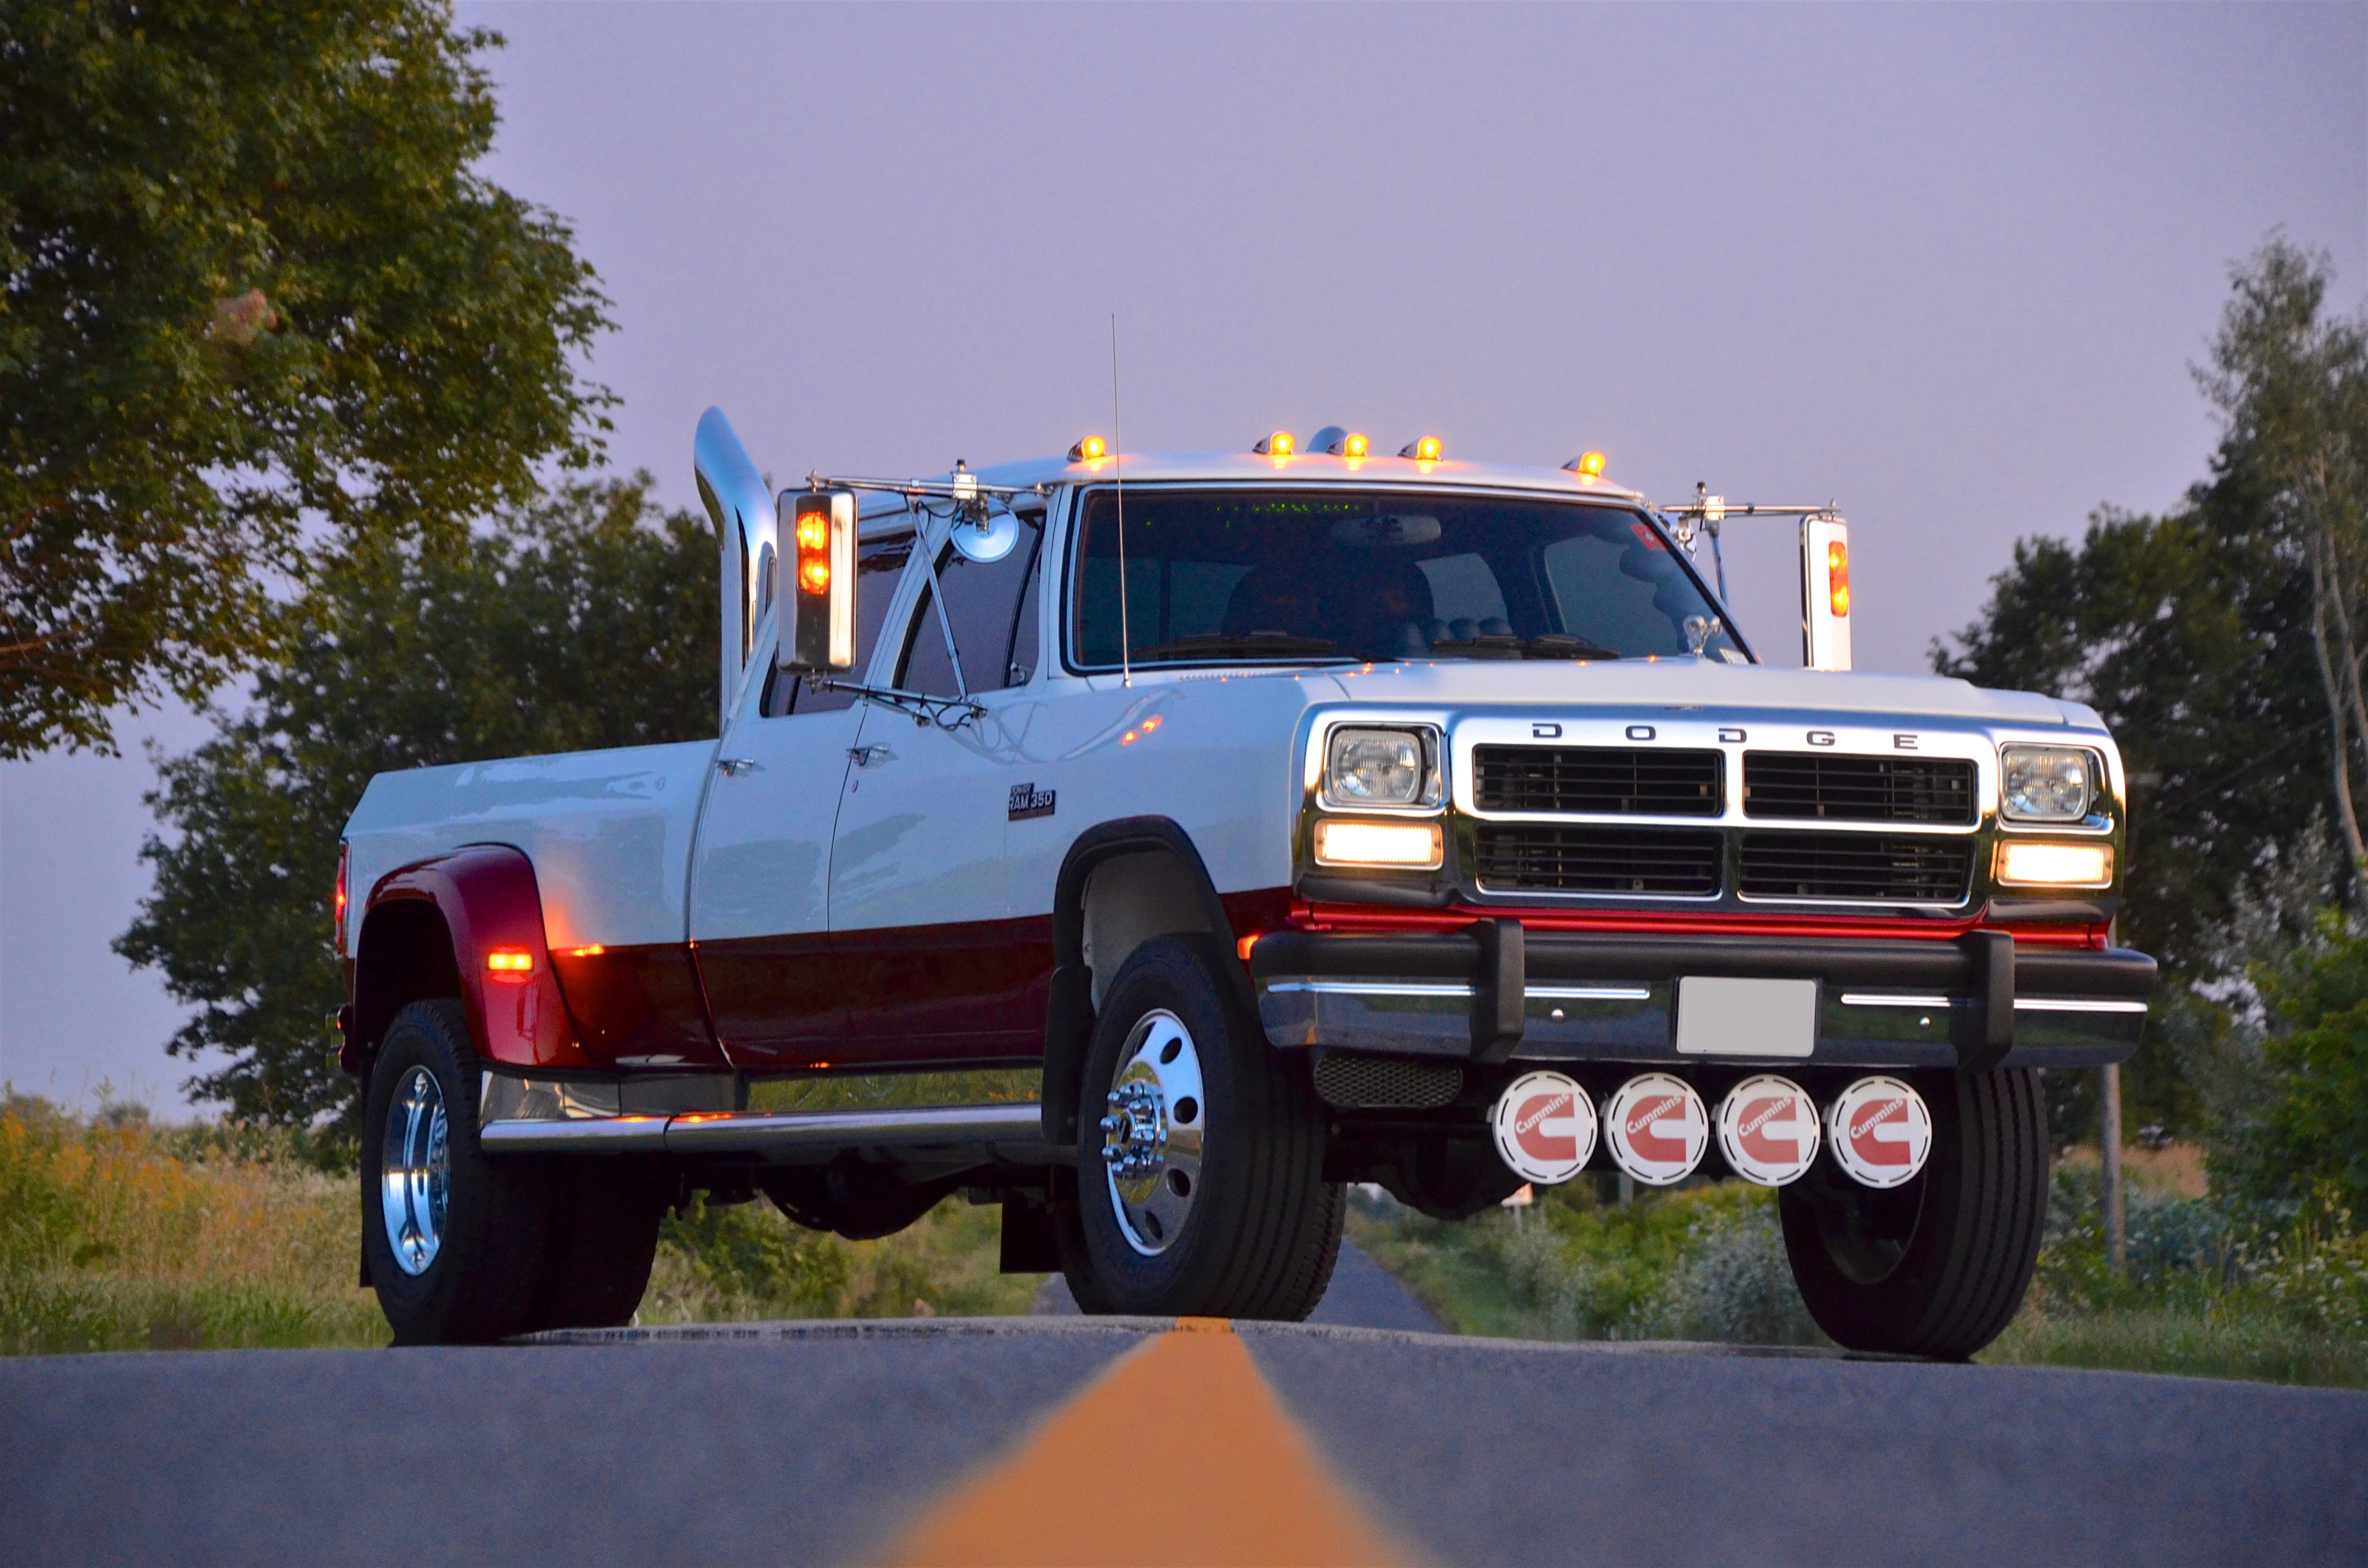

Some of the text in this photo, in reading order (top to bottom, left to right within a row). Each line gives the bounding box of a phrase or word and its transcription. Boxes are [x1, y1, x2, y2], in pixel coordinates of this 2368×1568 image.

[1532, 723, 1919, 750] DODGE
[1008, 791, 1052, 811] RAM 350
[1515, 1093, 1570, 1134] Cummins
[1626, 1095, 1682, 1134] Cummins
[1738, 1096, 1792, 1137] Cummins
[1850, 1098, 1904, 1139] Cummins
